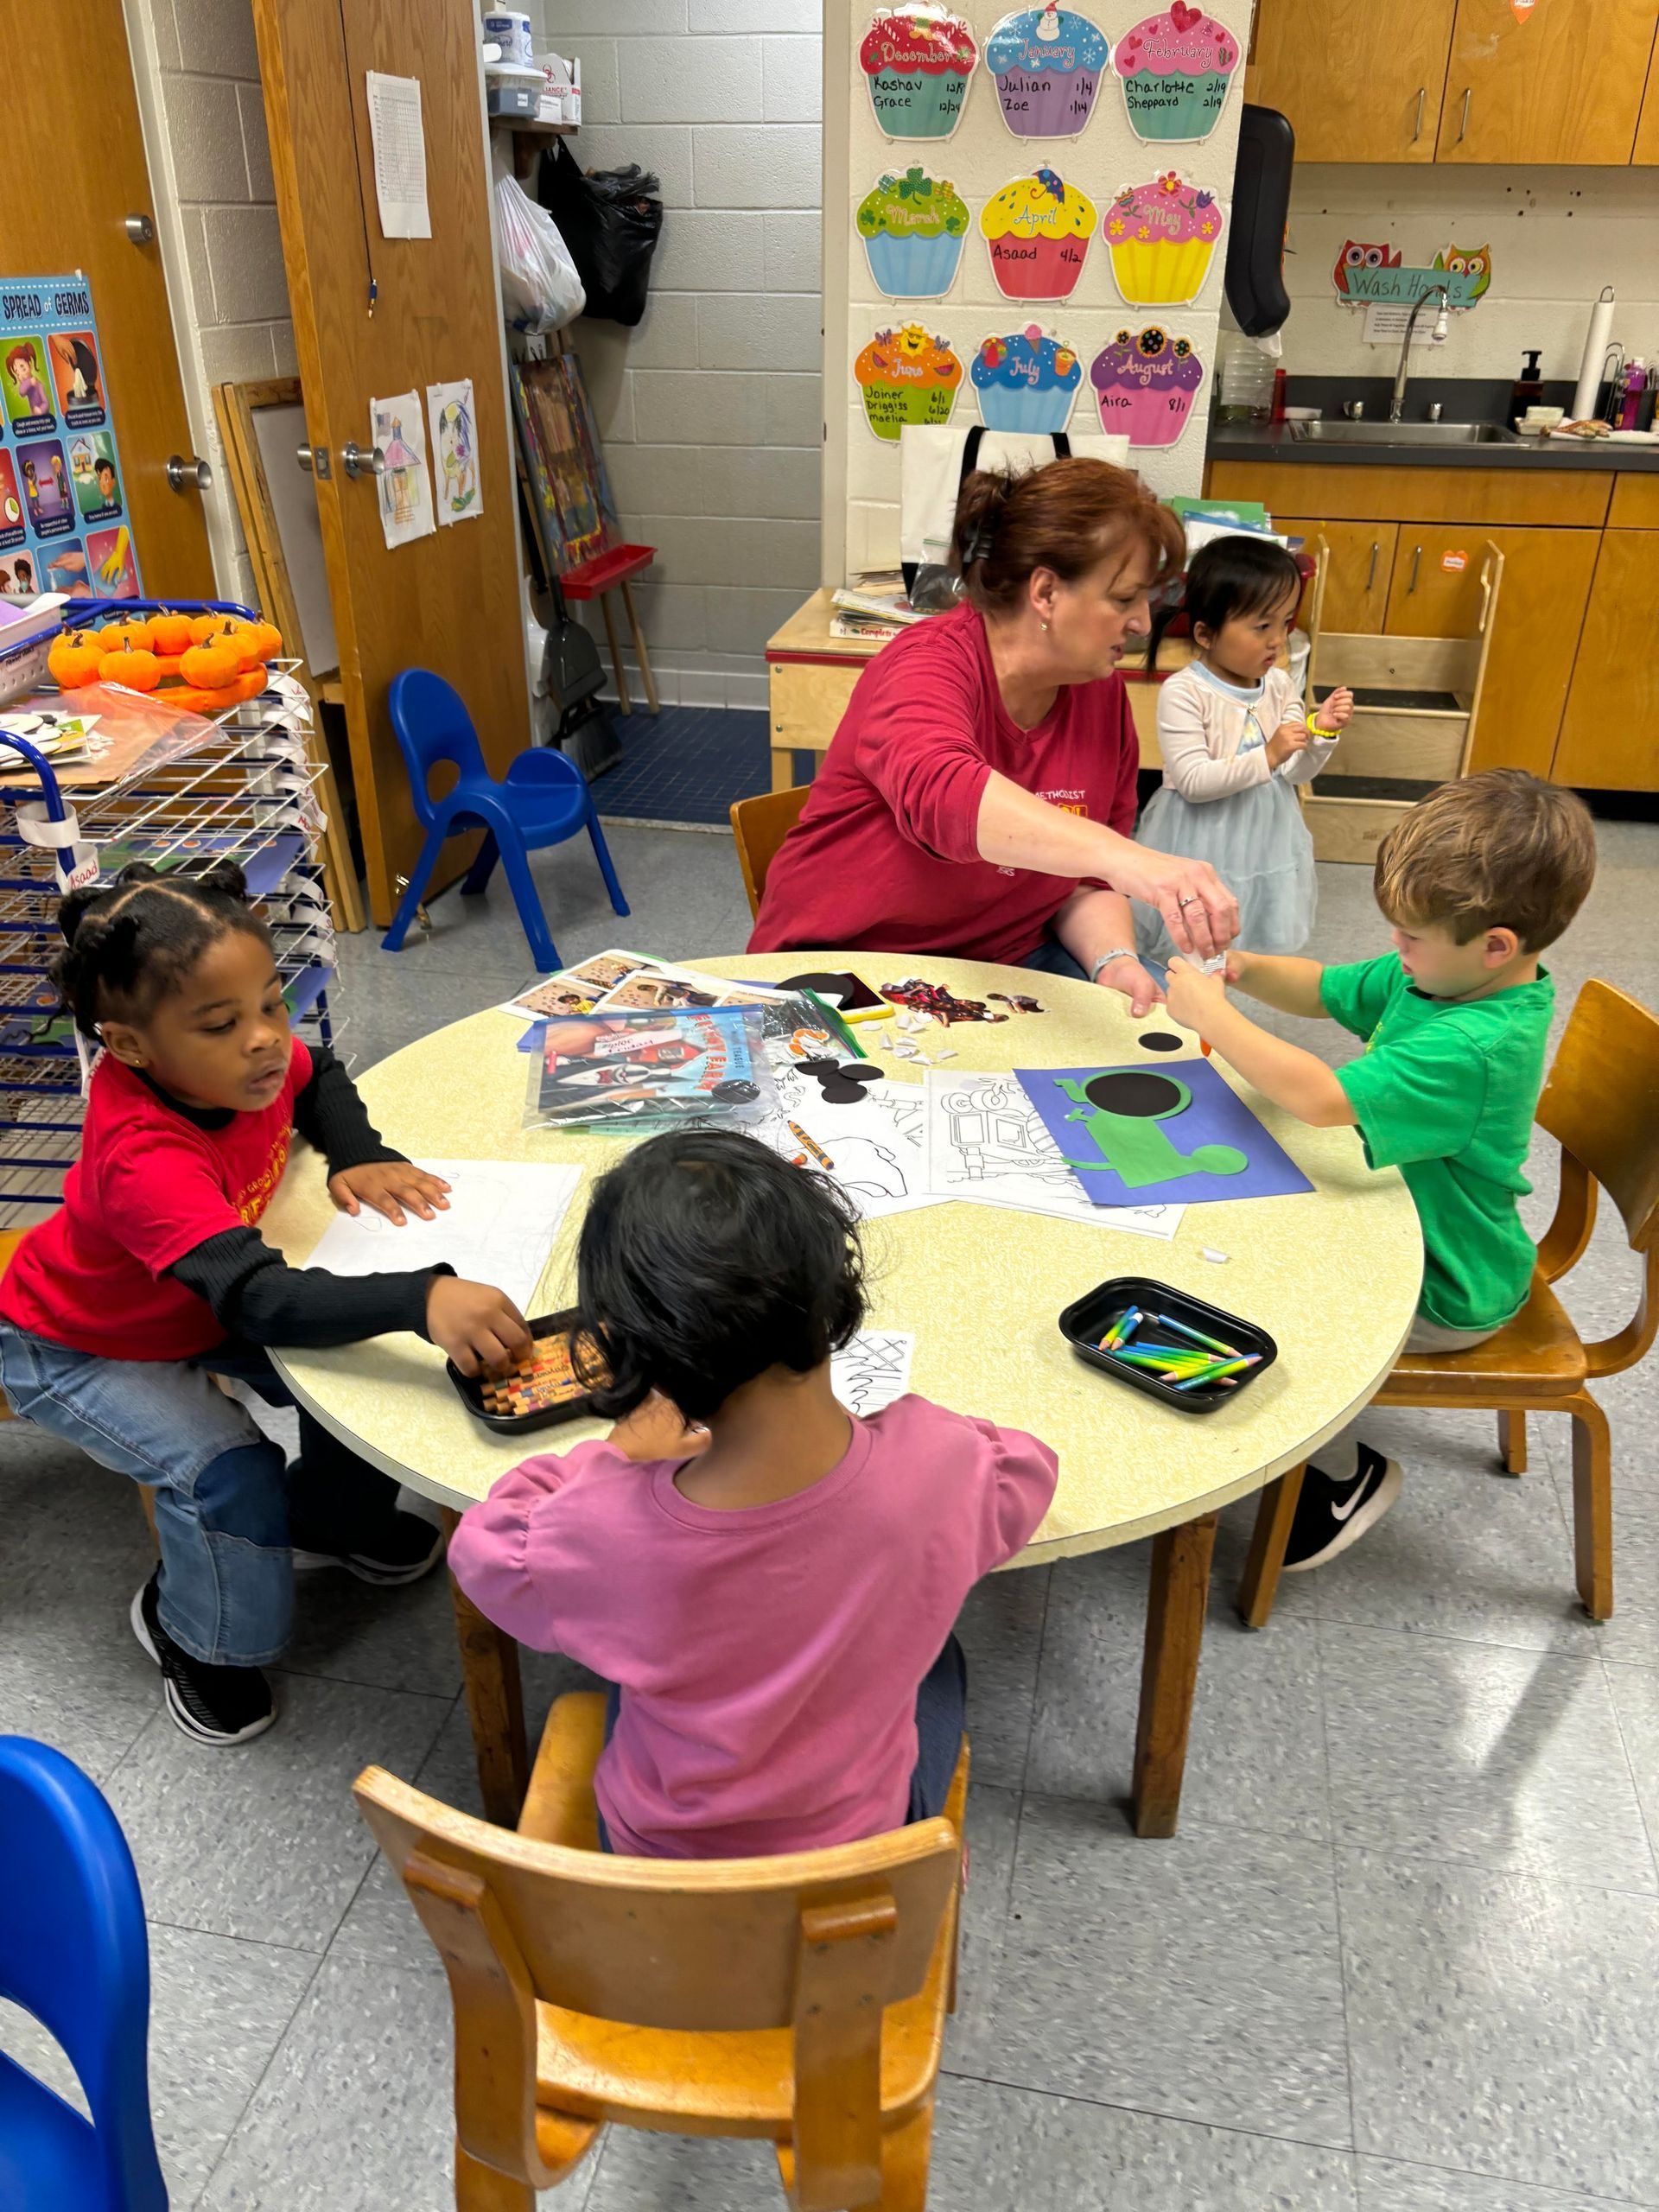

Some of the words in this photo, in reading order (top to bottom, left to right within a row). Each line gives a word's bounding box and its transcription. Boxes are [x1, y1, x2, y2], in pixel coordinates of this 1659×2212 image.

[880, 41, 951, 62] December
[1019, 39, 1075, 68] January
[1143, 38, 1213, 69] February
[1000, 75, 1051, 92] Julian
[1077, 77, 1092, 96] 1/4
[1126, 79, 1194, 93] Charlotte
[1206, 79, 1226, 94] 2/19
[874, 96, 912, 110] Grace
[939, 99, 960, 114] 12/24
[1004, 98, 1029, 111] Zoe
[1070, 100, 1087, 115] 1/14
[1127, 96, 1179, 110] Sheppard
[1203, 95, 1222, 109] 2/19
[886, 204, 940, 226] March
[1014, 204, 1058, 235] April
[1143, 204, 1181, 236] May
[994, 245, 1037, 259] Asaad
[1060, 248, 1082, 263] 4/2
[1353, 270, 1401, 296] Wash
[3, 294, 41, 320] SPREAD
[44, 296, 52, 312] of
[54, 291, 89, 315] GERMS
[891, 358, 923, 378] June
[1009, 356, 1040, 385] July
[1116, 353, 1173, 385] August
[865, 386, 904, 399] Joiner
[931, 391, 944, 404] 6/1
[1101, 396, 1132, 408] Aira
[1168, 397, 1185, 412] 8/1
[866, 401, 908, 413] Driggiss
[70, 858, 98, 890] Asaad
